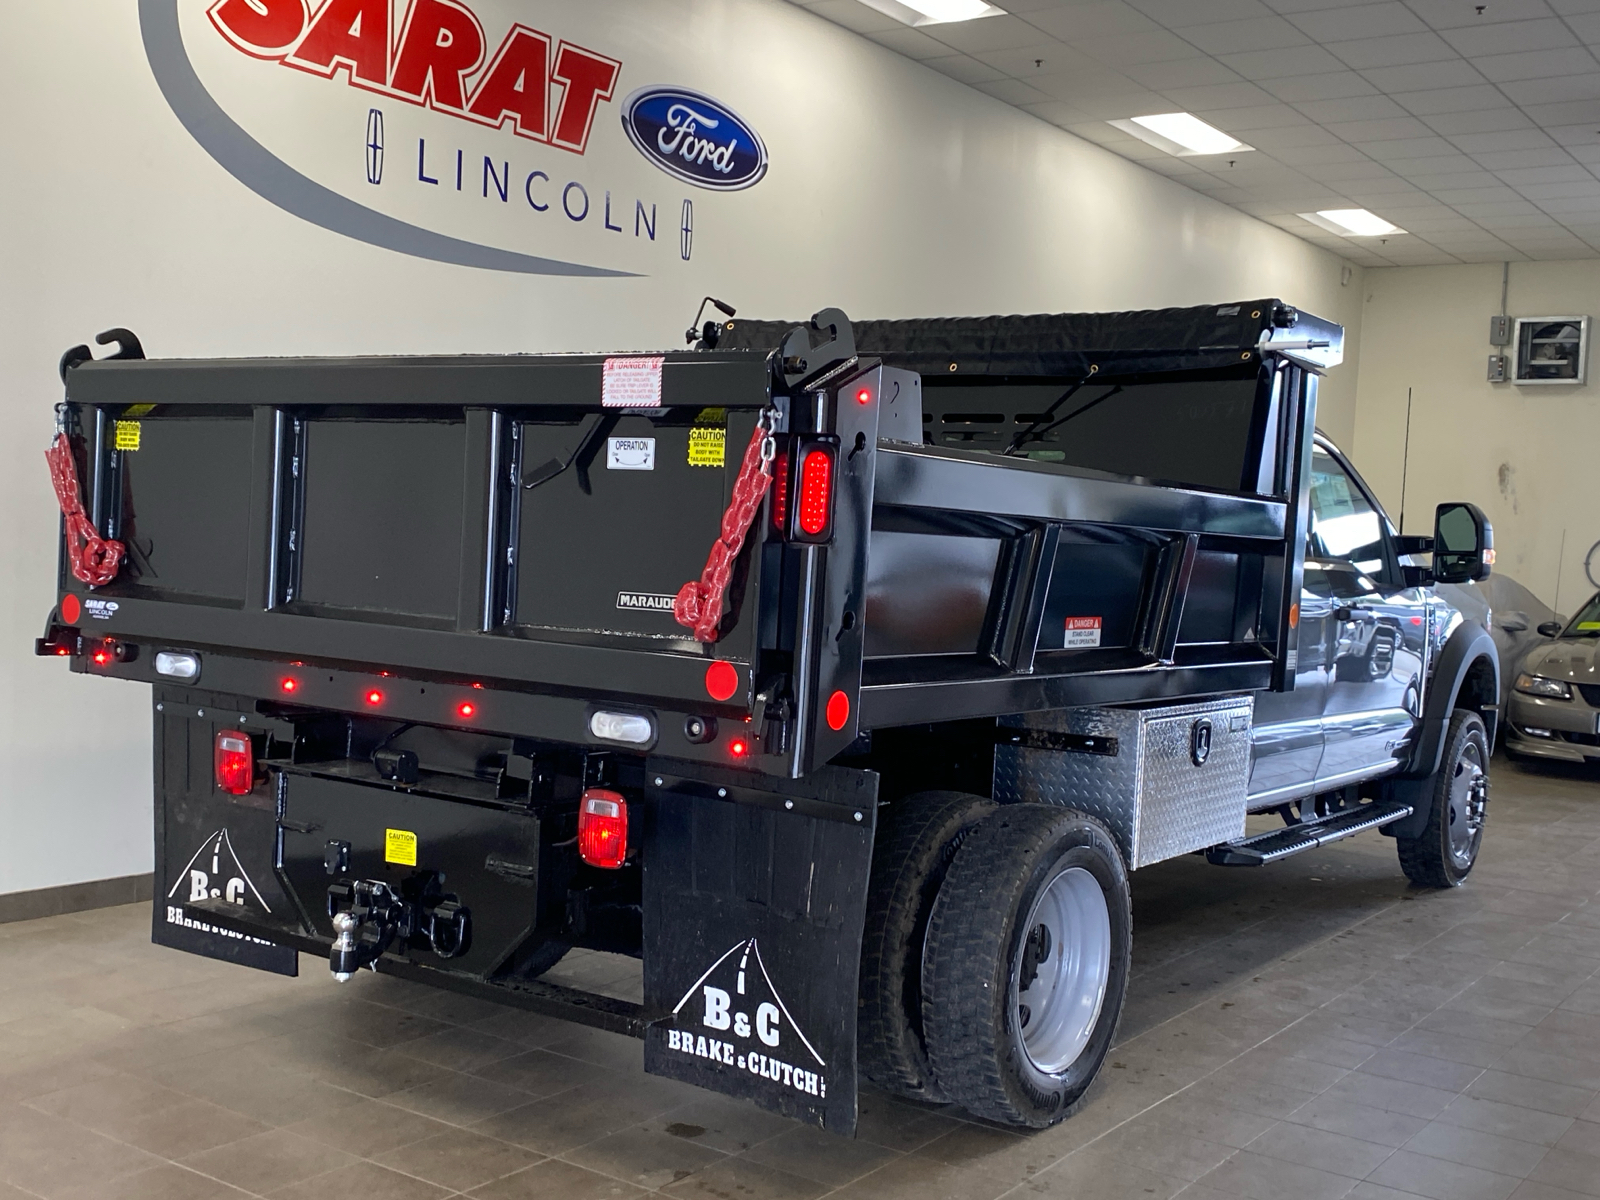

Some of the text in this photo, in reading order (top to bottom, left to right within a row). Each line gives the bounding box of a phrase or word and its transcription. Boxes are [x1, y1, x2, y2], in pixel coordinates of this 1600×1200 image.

[657, 104, 738, 174] Ford
[418, 138, 657, 241] LINCOLN
[691, 431, 726, 440] CAUTION
[615, 440, 649, 451] OPERATION
[620, 595, 676, 609] MARAUDE
[1074, 619, 1094, 628] DANGER
[389, 832, 415, 842] CAUTION
[668, 1030, 734, 1066] BRAKE
[737, 1054, 746, 1069] &
[748, 1051, 818, 1096] CLUTCH
